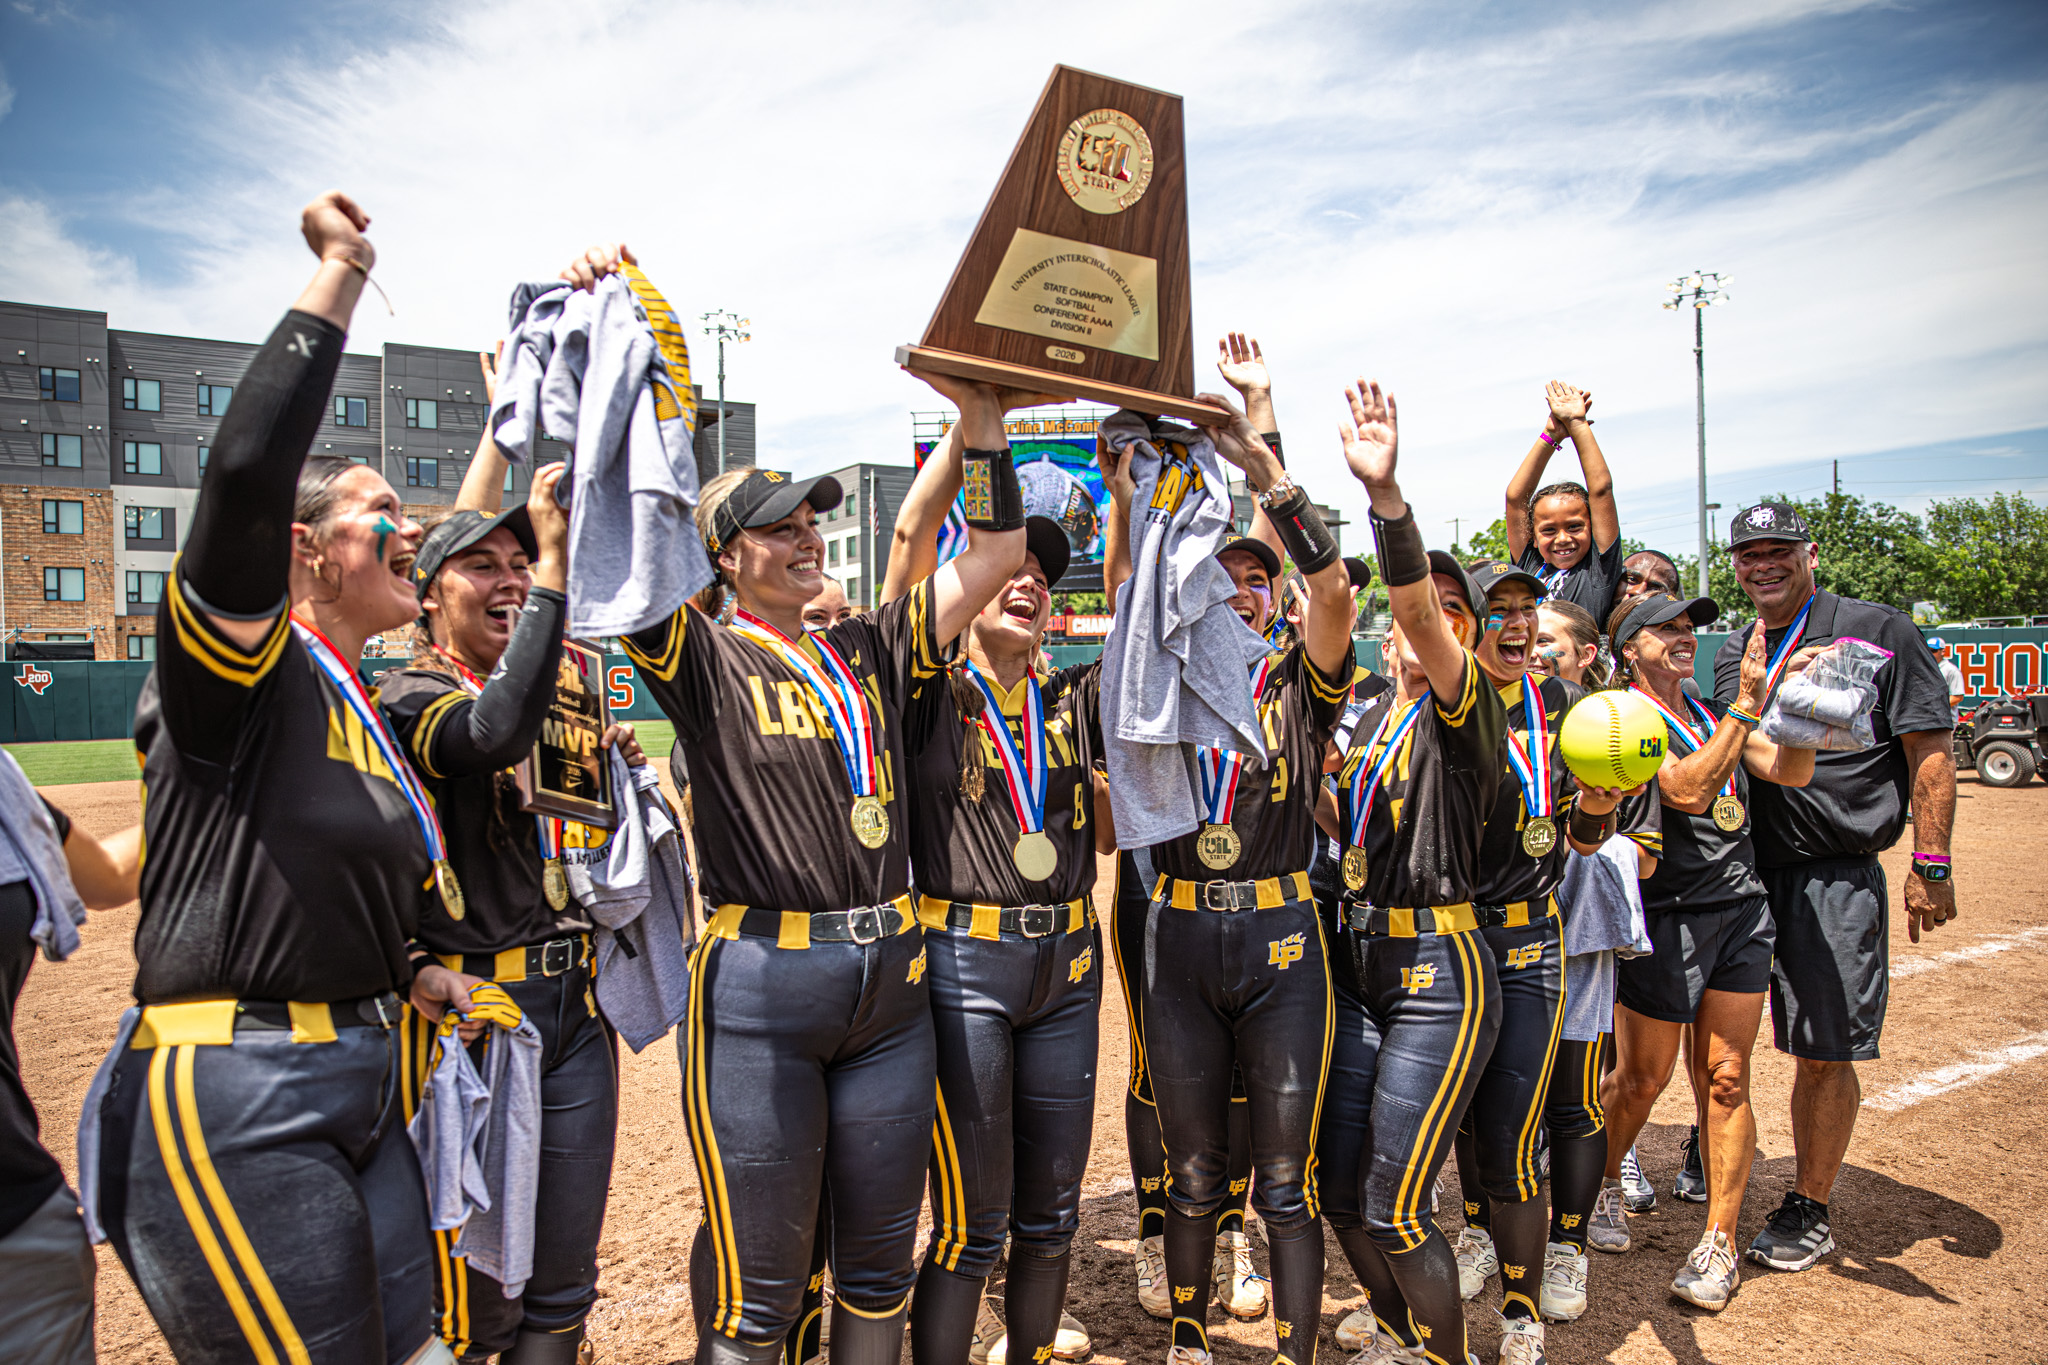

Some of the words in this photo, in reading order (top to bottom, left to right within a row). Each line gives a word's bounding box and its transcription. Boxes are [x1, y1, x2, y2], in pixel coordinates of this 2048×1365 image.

[1011, 256, 1055, 291] UNIVERSITY
[1056, 253, 1126, 287] INTERSCHOLASTIC
[1122, 284, 1141, 317] LEAGUE
[1043, 281, 1068, 295] STATE
[1069, 287, 1114, 305] CHAMPION
[1055, 296, 1097, 313] SOFTBALL
[1033, 303, 1089, 323] CONFERENCE
[1090, 316, 1113, 329] AAAA
[1051, 319, 1085, 334] DIVISION
[1055, 348, 1077, 361] 2026
[1004, 420, 1040, 434] arline
[1044, 419, 1101, 434] McComb
[28, 673, 49, 683] 200
[543, 717, 599, 757] MVP
